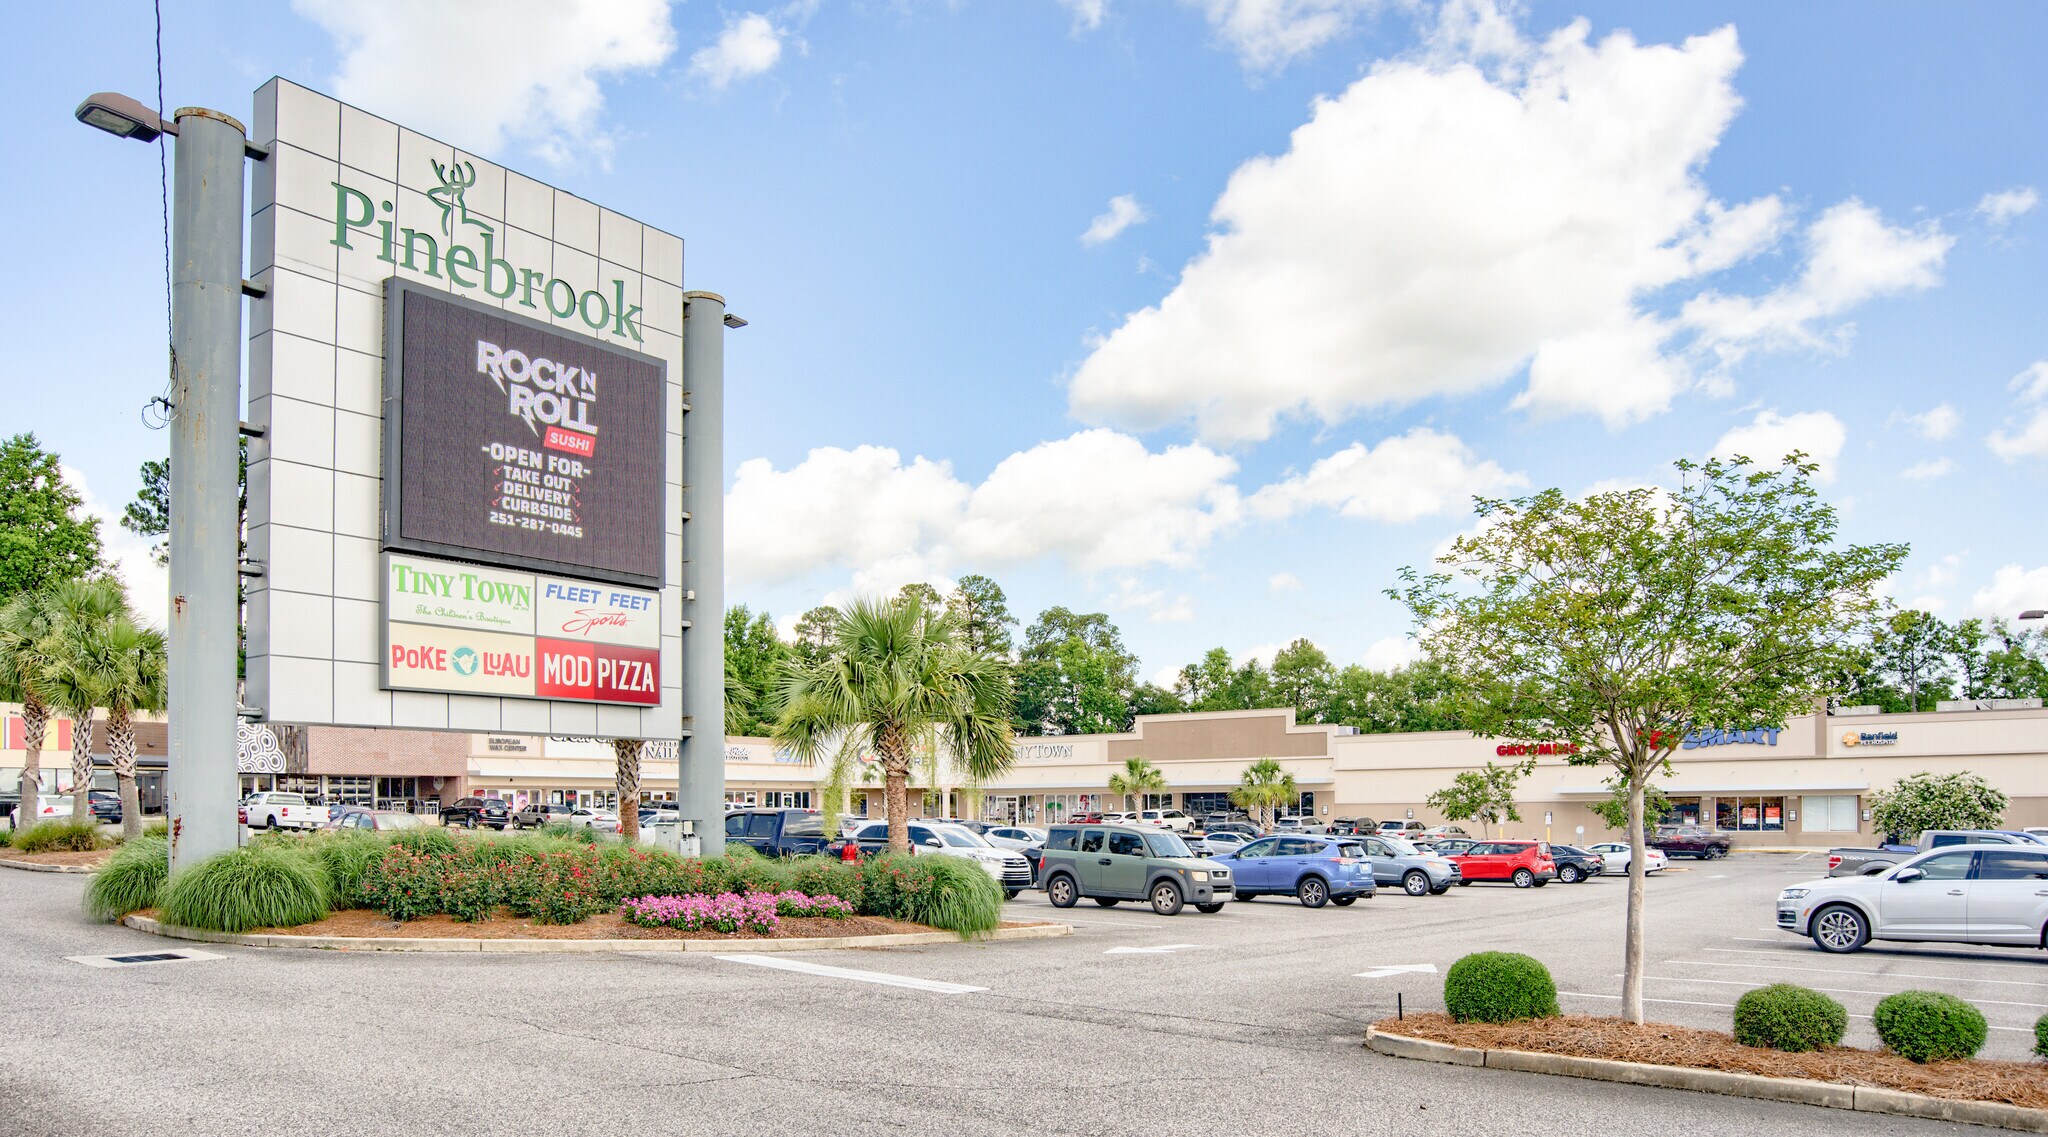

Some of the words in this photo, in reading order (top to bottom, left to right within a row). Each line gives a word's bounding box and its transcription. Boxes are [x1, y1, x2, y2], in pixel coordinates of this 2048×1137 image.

[330, 181, 645, 343] Pinebrook
[478, 340, 580, 398] ROCK
[511, 383, 598, 437] ROLL
[549, 431, 590, 451] SUSHI
[503, 465, 540, 484] TAKE
[543, 474, 571, 491] OUT
[503, 481, 571, 506] DELIVERY
[501, 497, 572, 521] CURBSIDE
[490, 511, 583, 538] 251-287-0445
[392, 564, 455, 597] TINY
[459, 572, 531, 607] TOWN
[545, 584, 601, 604] FLEET
[609, 593, 651, 611] FEET
[415, 604, 432, 616] The
[434, 606, 474, 621] Children's
[476, 611, 512, 625] Boutique
[562, 609, 635, 636] Sports
[392, 645, 447, 671] POKE
[483, 652, 530, 678] LUAU
[544, 653, 592, 687] MOD
[598, 658, 655, 692] PIZZA
[1861, 731, 1898, 741] Banfield
[1033, 744, 1073, 758] TOWN
